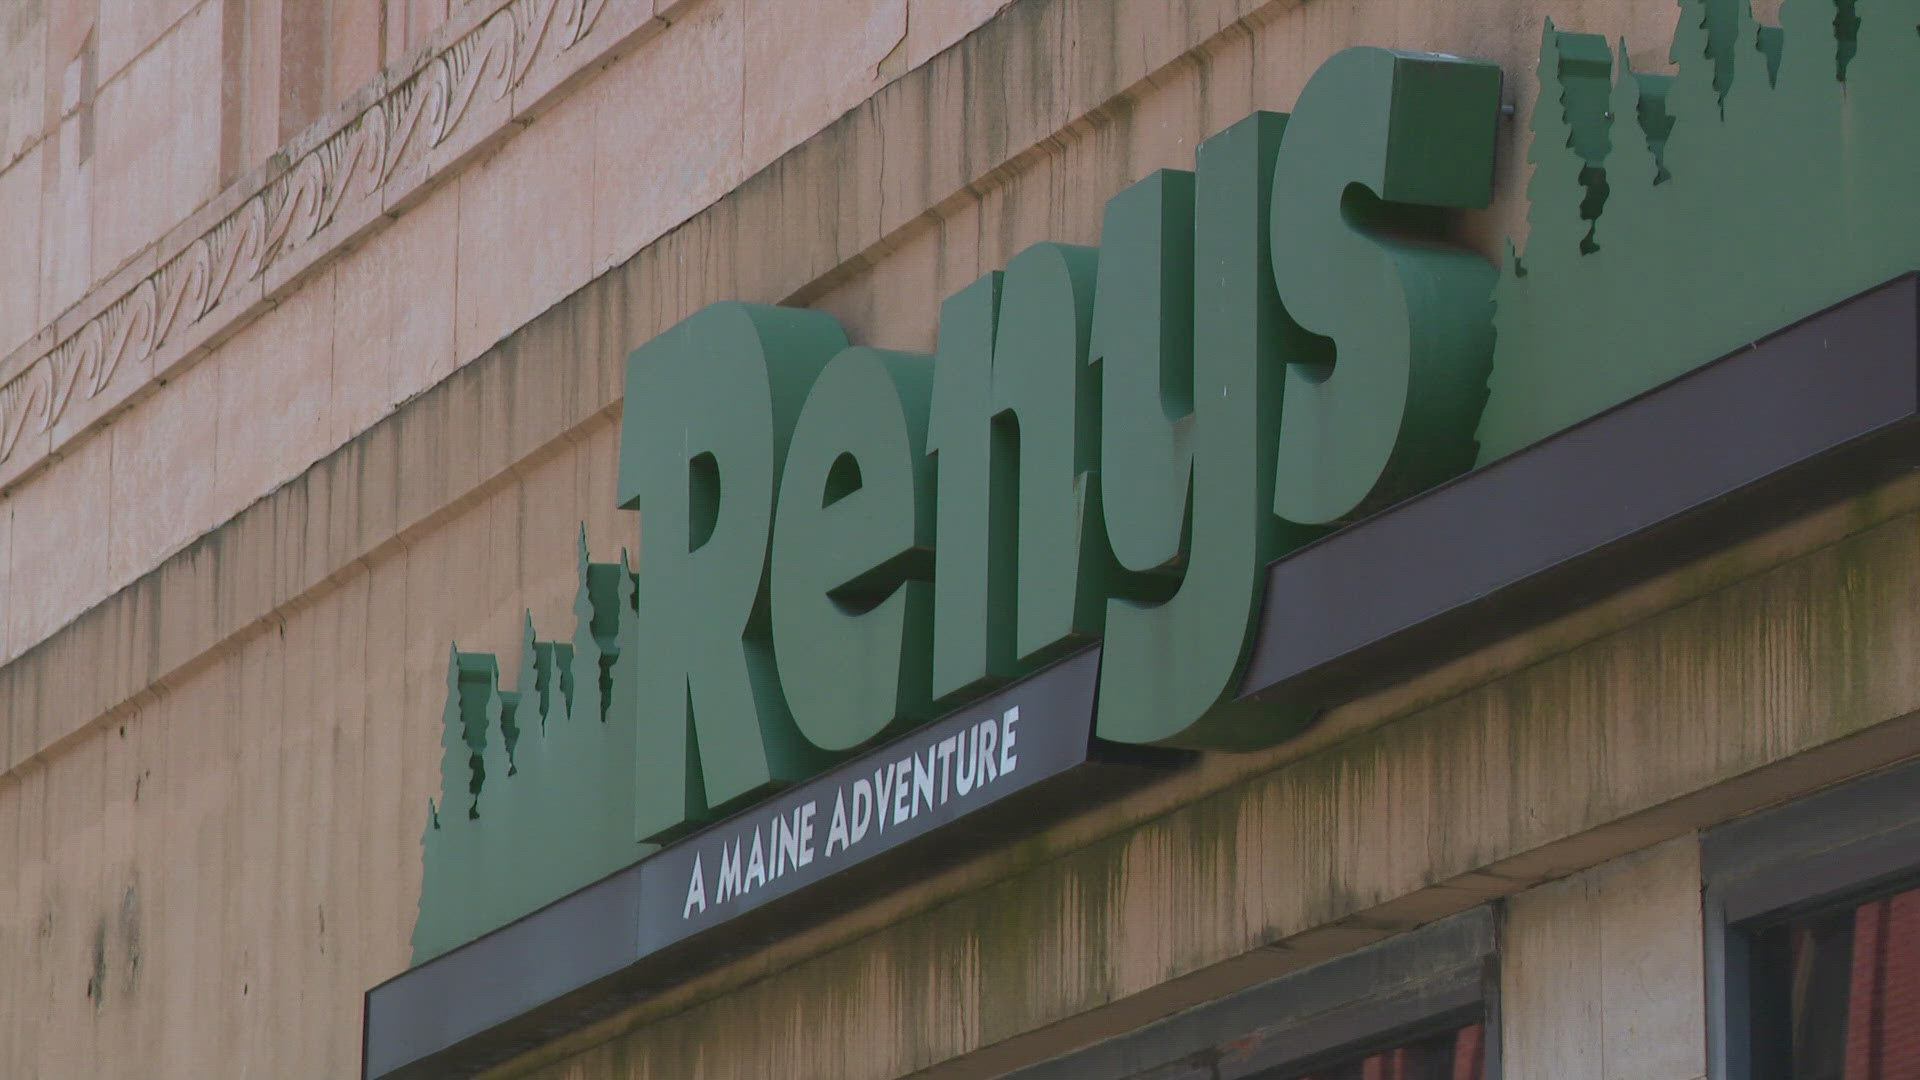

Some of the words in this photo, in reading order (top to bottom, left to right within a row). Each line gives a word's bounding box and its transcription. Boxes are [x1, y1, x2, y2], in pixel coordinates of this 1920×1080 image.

[617, 46, 1412, 842] Renys
[683, 850, 707, 919] A
[716, 801, 817, 904] MAINE
[825, 705, 1020, 858] ADVENTURE
